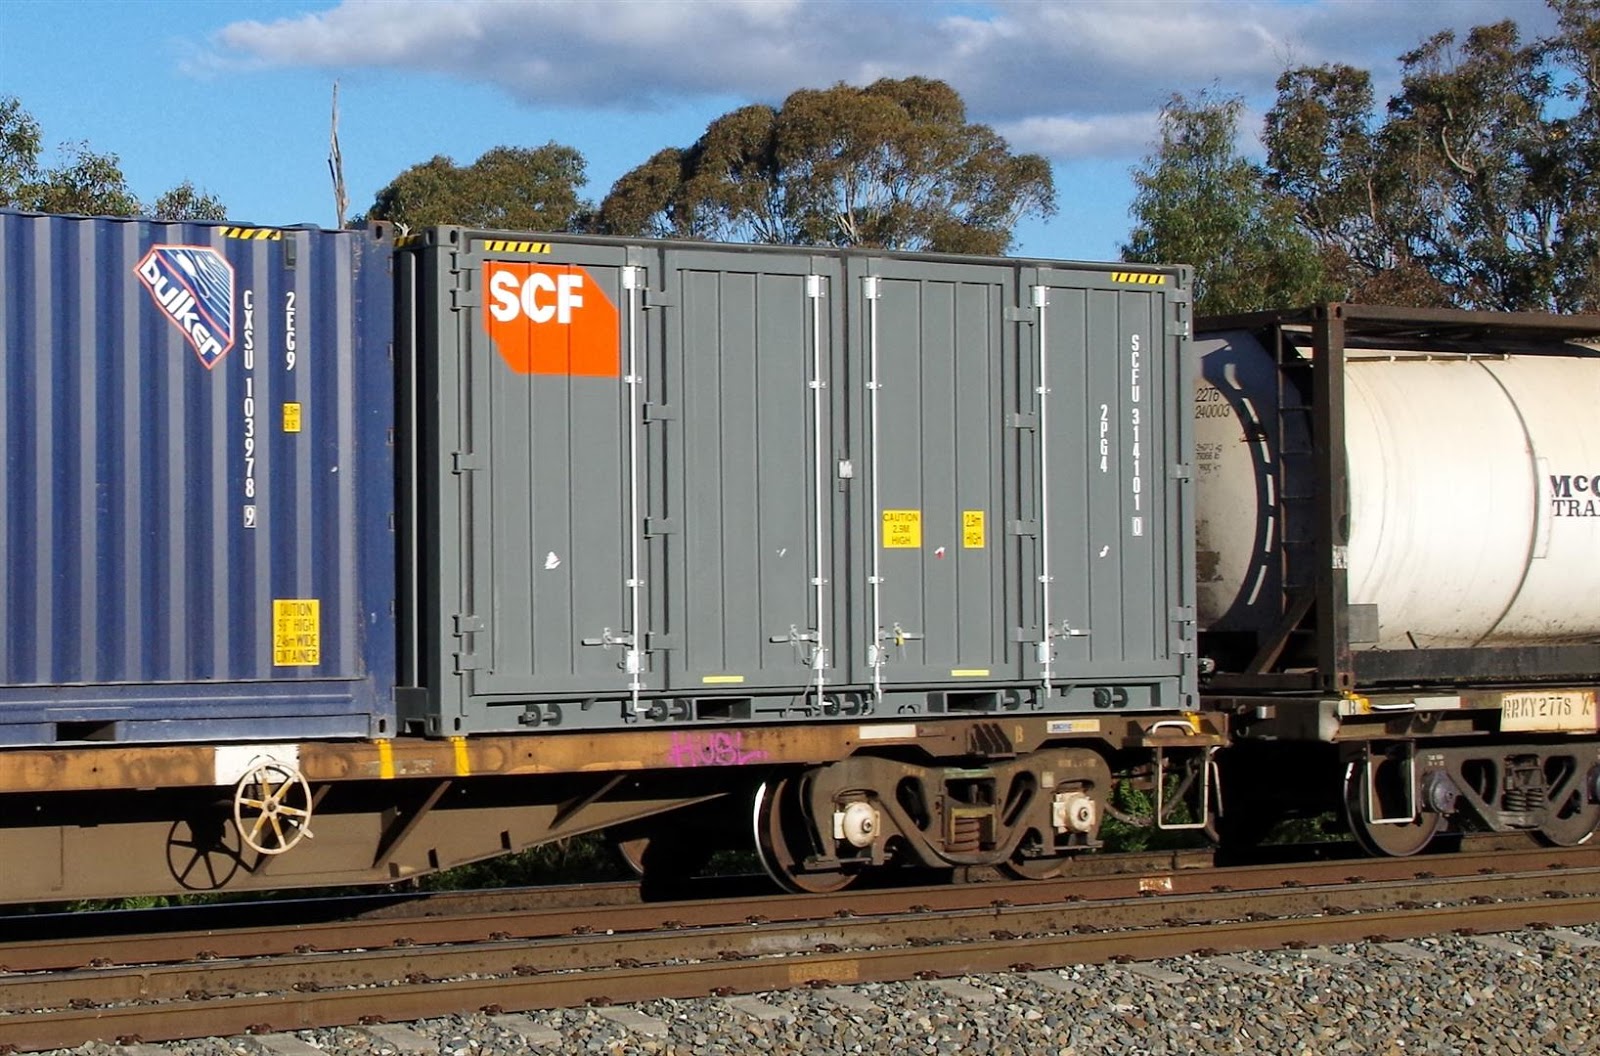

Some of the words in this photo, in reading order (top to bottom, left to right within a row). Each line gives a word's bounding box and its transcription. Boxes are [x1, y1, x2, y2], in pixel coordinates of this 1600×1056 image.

[243, 289, 254, 370] CXSU
[285, 291, 296, 371] 2EG9
[489, 270, 583, 324] SCF
[1131, 334, 1140, 403] SCFU
[243, 377, 255, 498] 103978
[1100, 404, 1109, 473] 2PG4
[1131, 408, 1141, 511] 314101
[243, 504, 256, 527] 9
[882, 513, 918, 522] CAUTION
[1552, 499, 1600, 517] TRA
